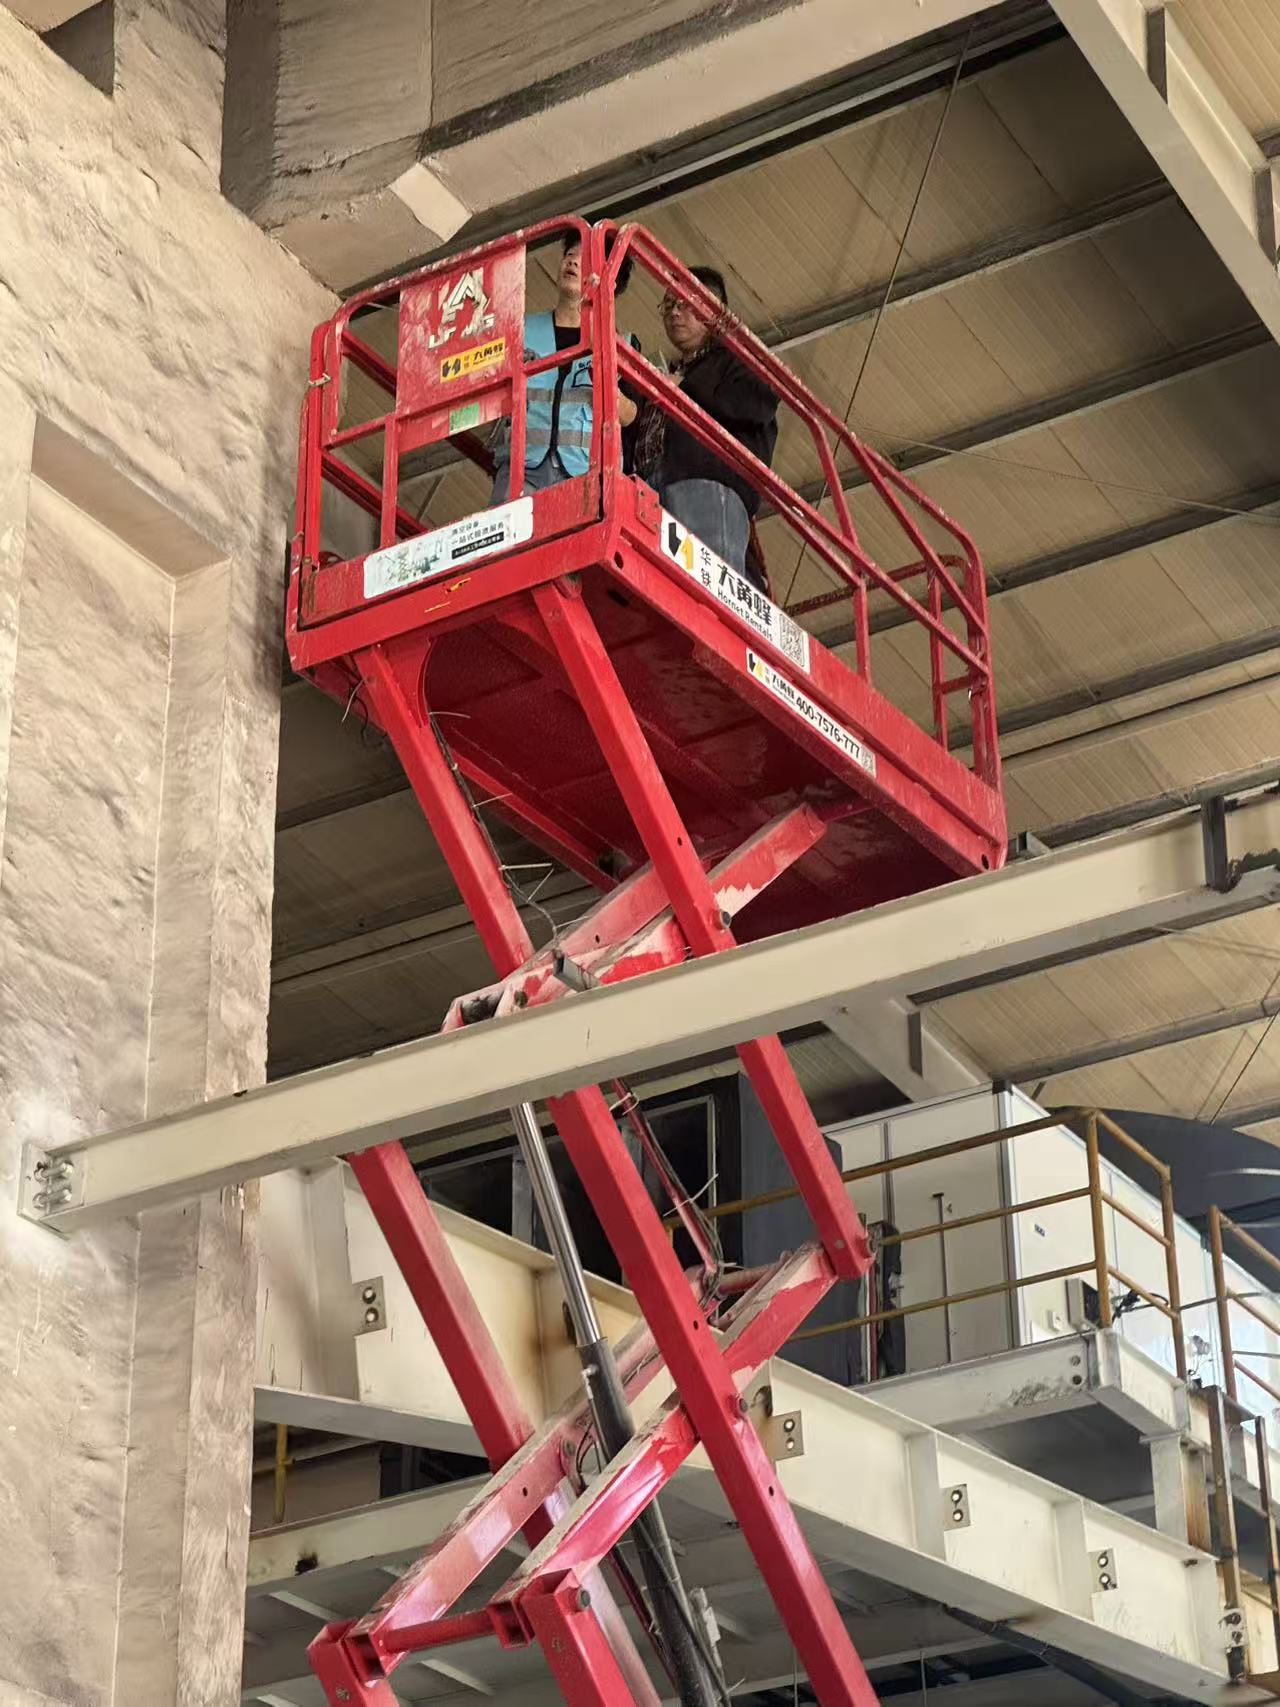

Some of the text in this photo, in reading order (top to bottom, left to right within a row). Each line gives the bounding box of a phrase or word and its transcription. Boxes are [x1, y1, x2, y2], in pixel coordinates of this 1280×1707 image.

[717, 563, 772, 627] 大黄蜂
[717, 587, 773, 642] Hornet Rentals
[795, 696, 860, 759] 400-7576-777
